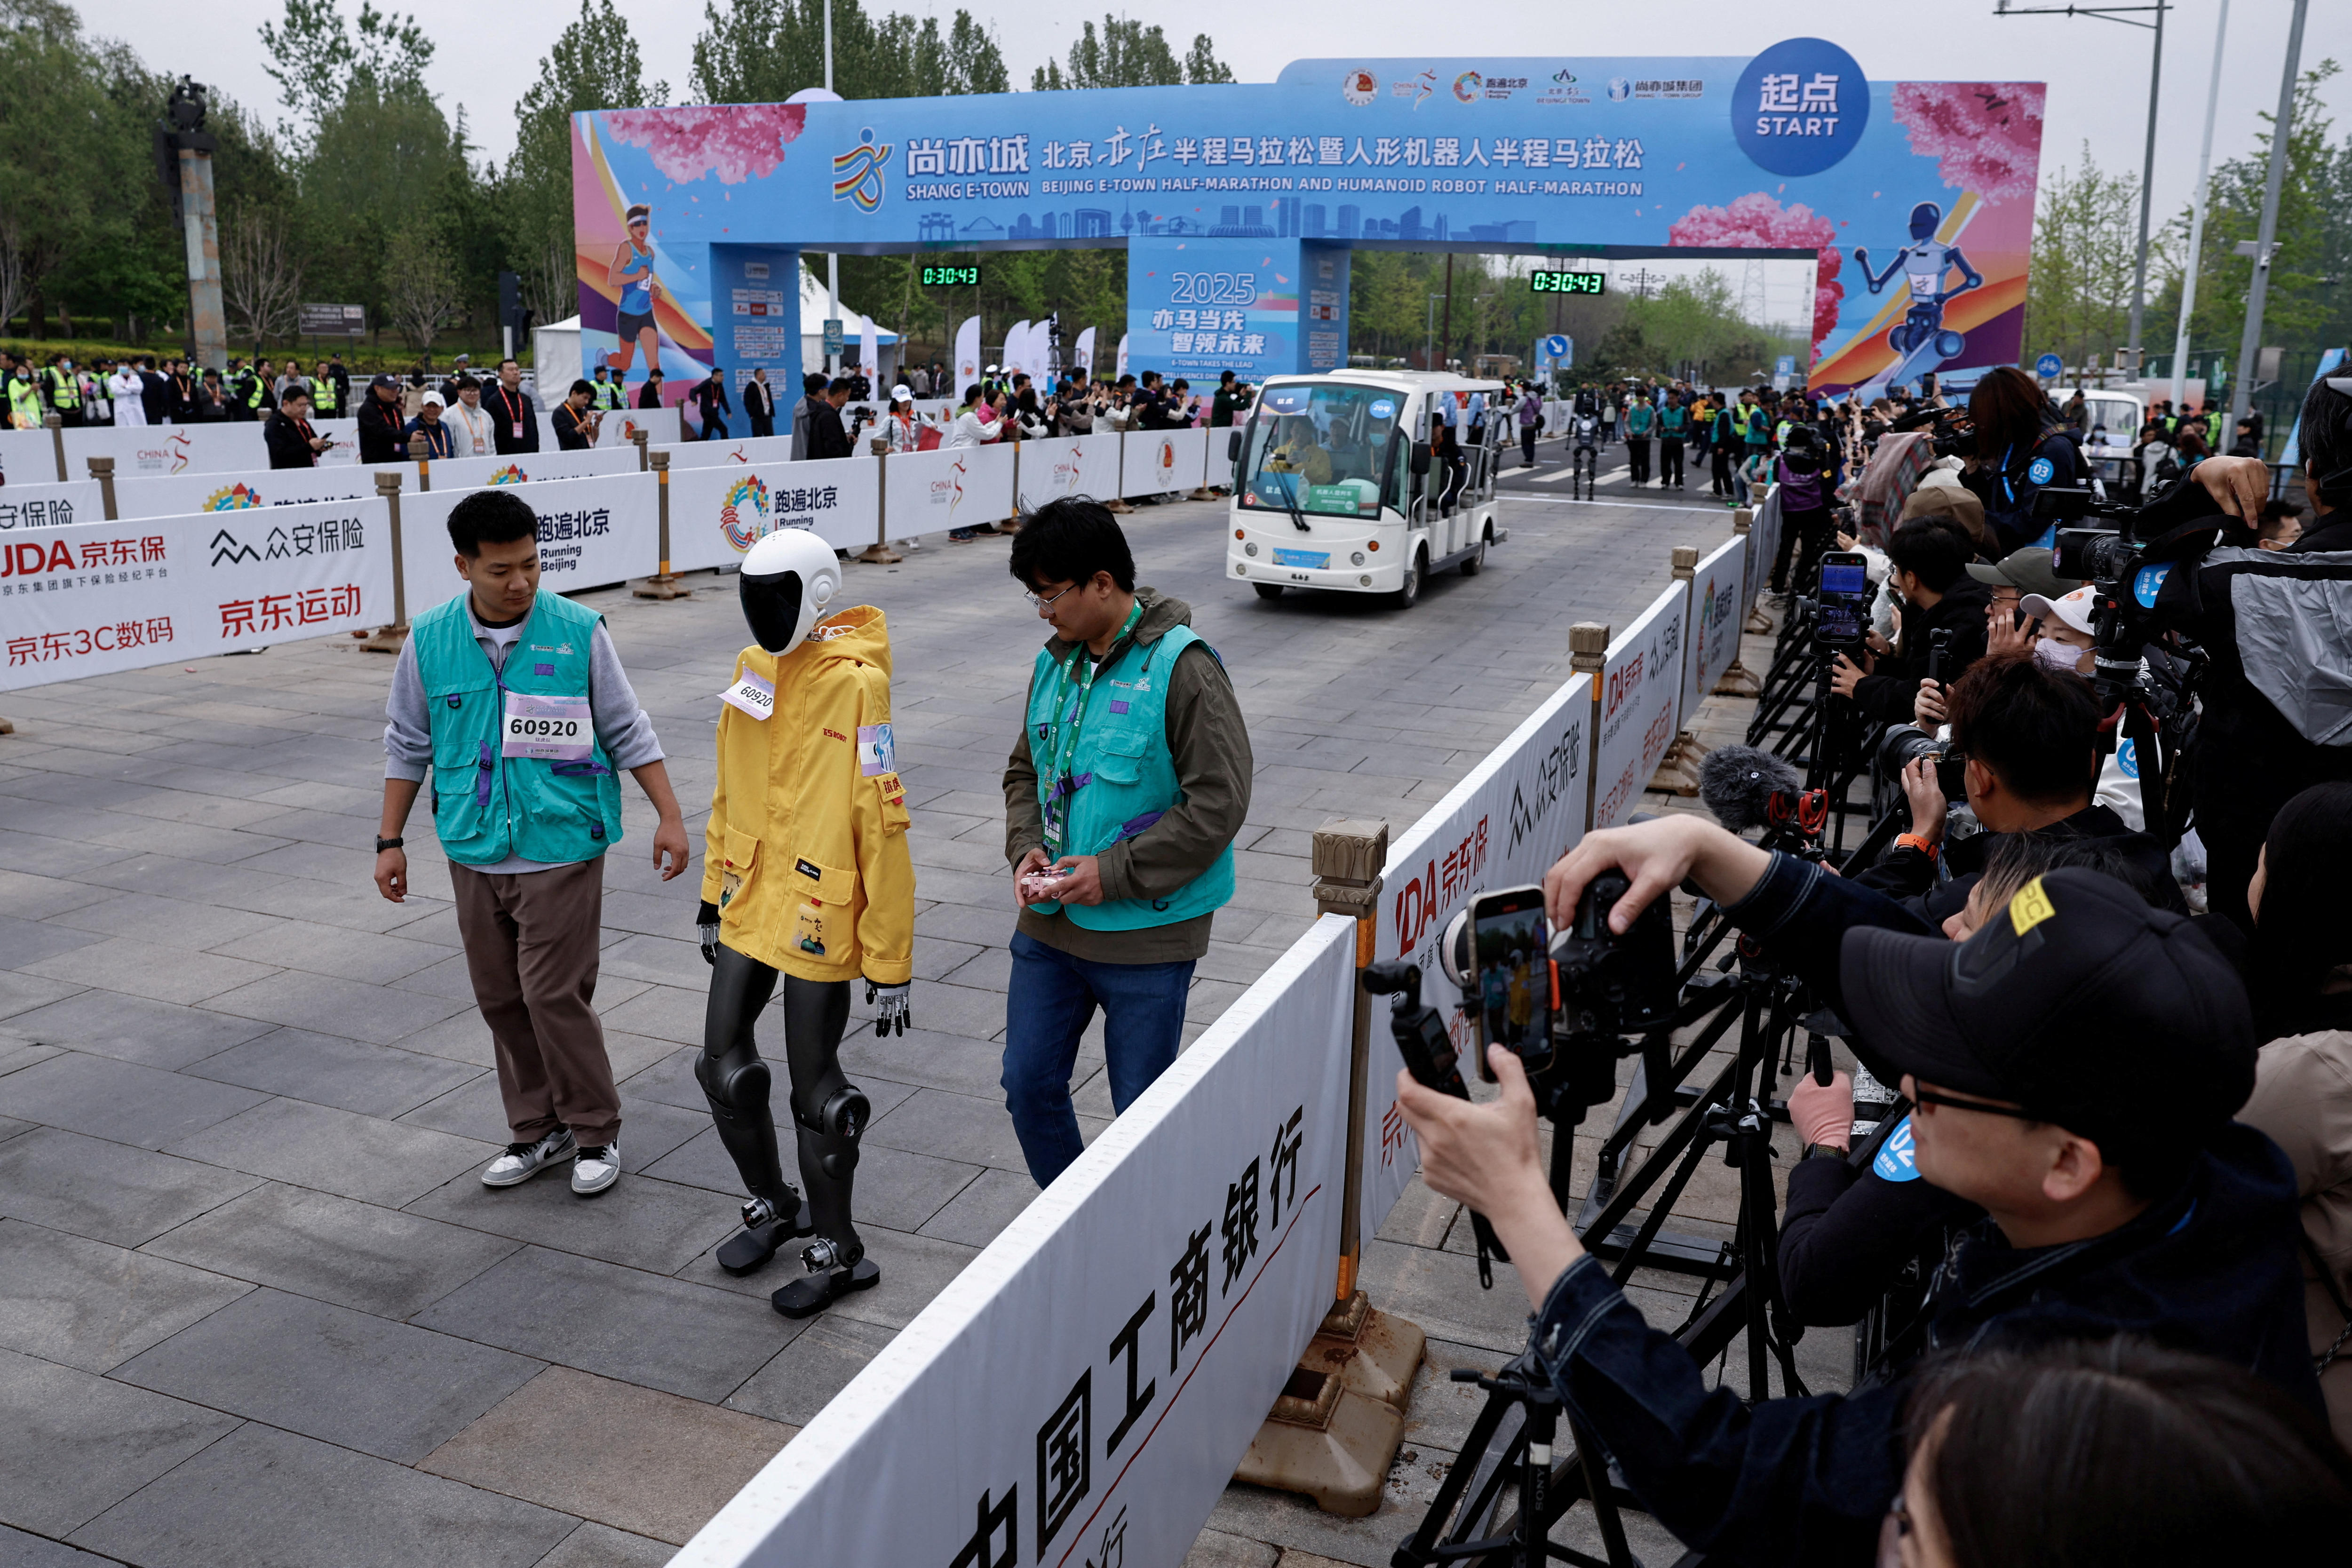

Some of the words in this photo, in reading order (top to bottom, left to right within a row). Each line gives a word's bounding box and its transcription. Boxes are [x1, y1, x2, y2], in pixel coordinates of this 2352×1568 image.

[1635, 80, 1703, 92] 尚亦城集团
[1759, 73, 1839, 112] 起点
[1756, 117, 1839, 136] START
[907, 134, 1029, 176] 尚亦城
[907, 183, 961, 200] SHANG
[967, 181, 1030, 198] E-TOWN
[1042, 179, 1094, 194] BEIJING
[1099, 179, 1156, 193] E-TOWN
[1162, 177, 1293, 191] HALF-MARATHON
[1299, 177, 1332, 191] AND
[1337, 178, 1426, 192] HUMANOID
[1432, 179, 1487, 193] ROBOT
[1495, 180, 1643, 196] HALF-MARATHON
[923, 267, 977, 285] 0:30:43
[1534, 272, 1602, 293] 0:30:43
[1171, 272, 1256, 305] 2025
[1152, 309, 1246, 331] 亦马当先
[1172, 333, 1265, 355] 智领未来
[136, 449, 169, 460] CHINA
[2033, 463, 2049, 478] 03
[931, 479, 951, 493] CHINA
[775, 486, 837, 514] 跑遍北京
[1246, 494, 1254, 505] 6
[537, 508, 610, 543] 跑遍北京
[779, 515, 813, 526] Running
[265, 517, 365, 561] 众安保险
[0, 540, 75, 577] JDA
[79, 535, 166, 569] 京东保
[540, 544, 581, 559] Running
[540, 558, 576, 573] Beijing
[2, 567, 168, 597] 京东集团旗下保险经纪平台
[219, 583, 361, 639] 京东运动
[6, 616, 174, 667] 京东3C数码
[740, 686, 772, 707] 60920
[1605, 665, 1624, 723] JDA
[510, 718, 578, 737] 60920
[833, 732, 847, 743] ROBOT
[1395, 859, 1437, 961] JDA
[1441, 814, 1487, 915] 京东保
